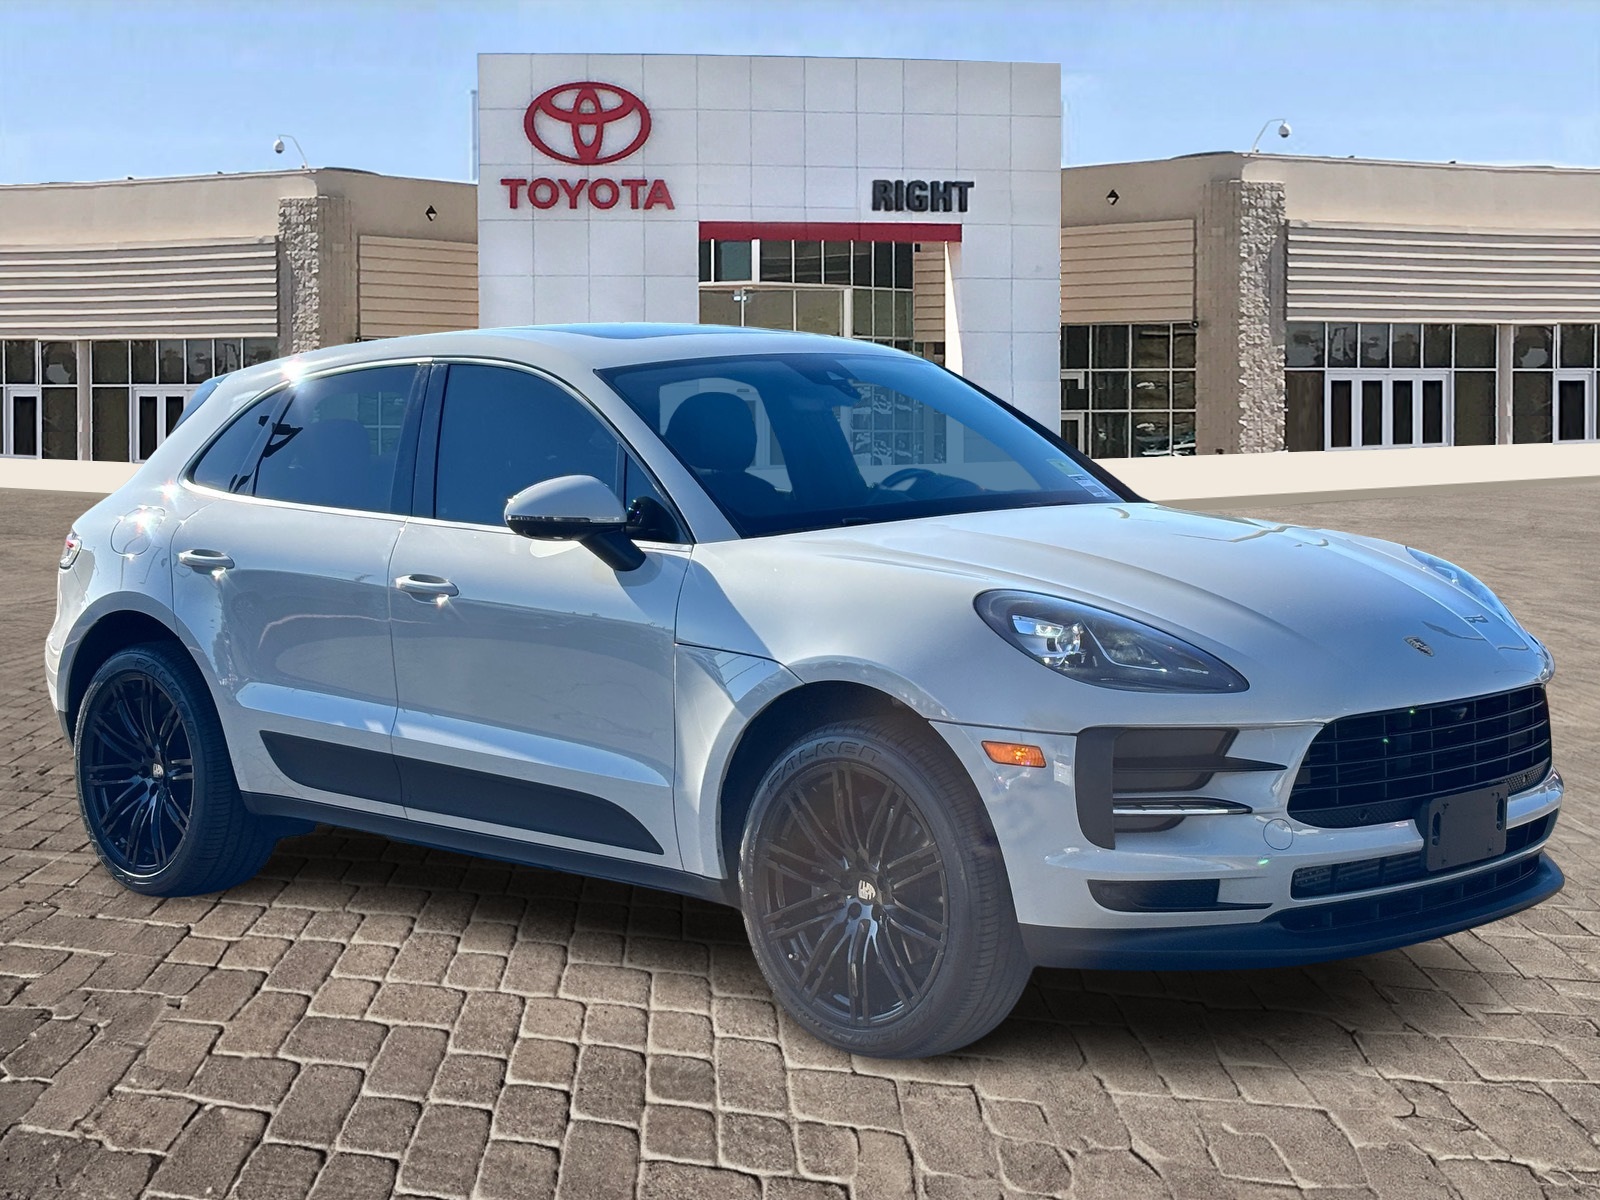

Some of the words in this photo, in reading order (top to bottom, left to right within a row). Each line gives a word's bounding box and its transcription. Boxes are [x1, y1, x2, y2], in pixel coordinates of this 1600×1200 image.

[501, 178, 675, 210] TOYOTA
[871, 179, 975, 213] RIGHT
[767, 741, 881, 796] FALKEN
